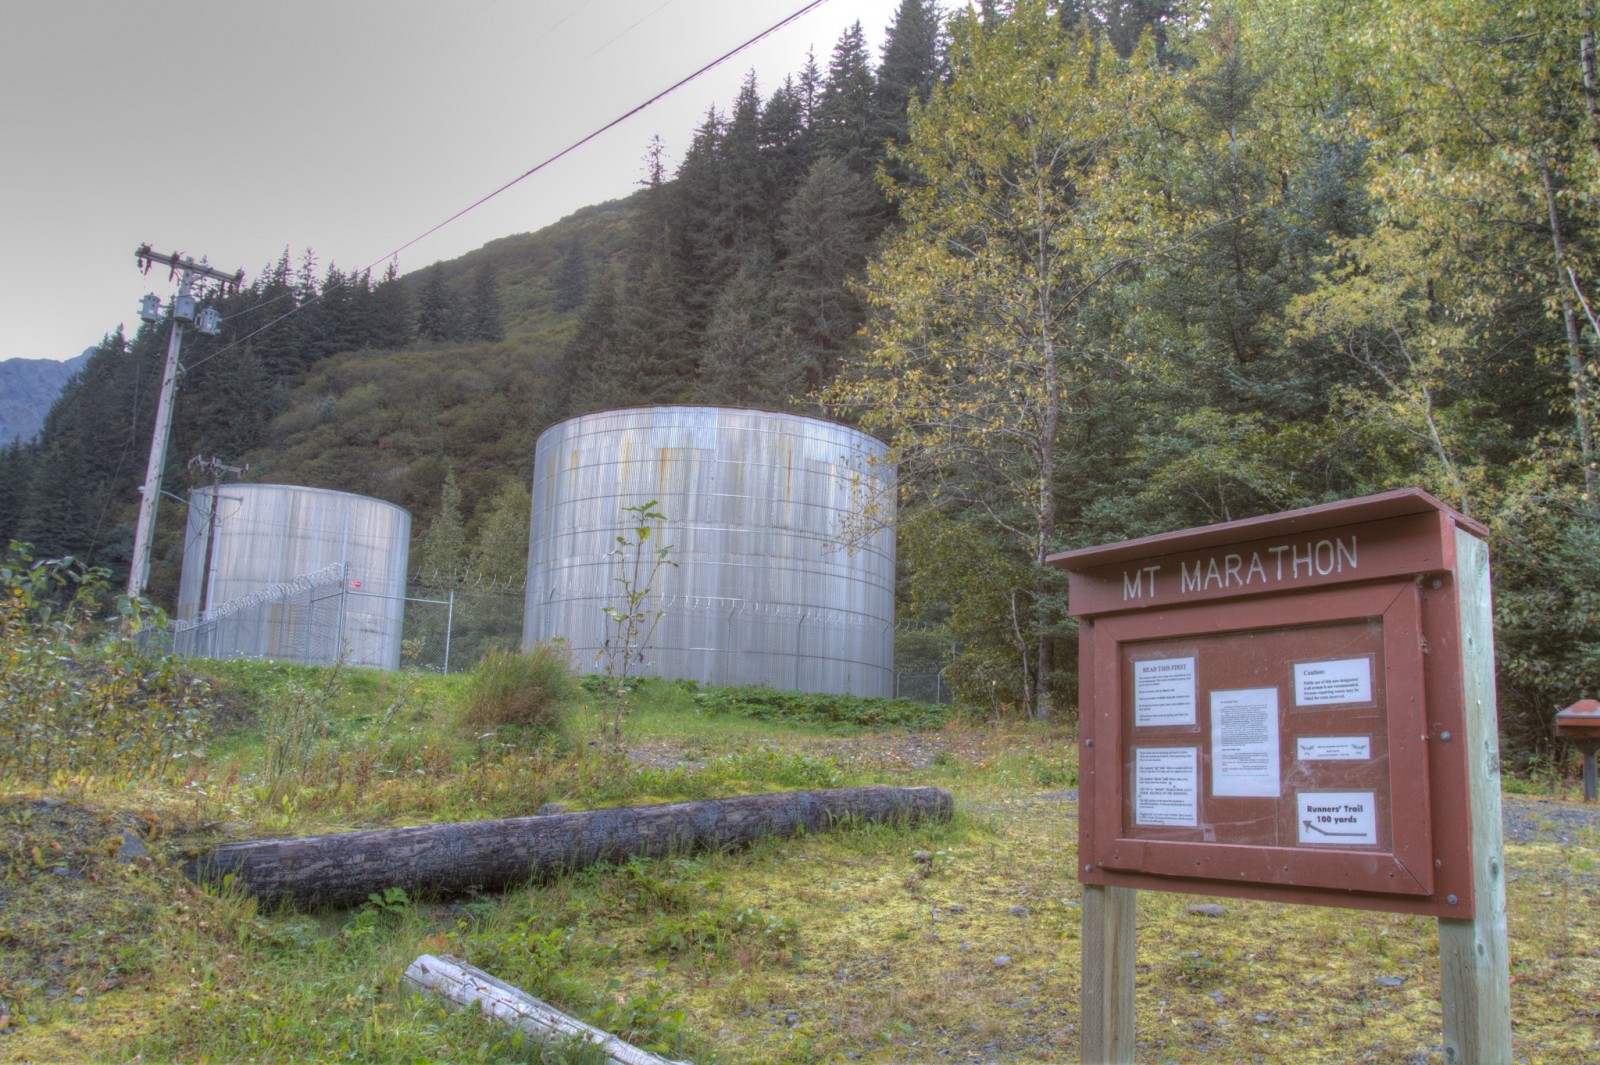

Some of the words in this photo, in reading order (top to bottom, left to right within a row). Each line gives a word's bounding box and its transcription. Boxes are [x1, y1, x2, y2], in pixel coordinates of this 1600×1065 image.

[1123, 565, 1161, 601] MT
[1181, 535, 1358, 594] MARATHON
[1171, 663, 1187, 671] FIRST
[1334, 816, 1357, 824] yards
